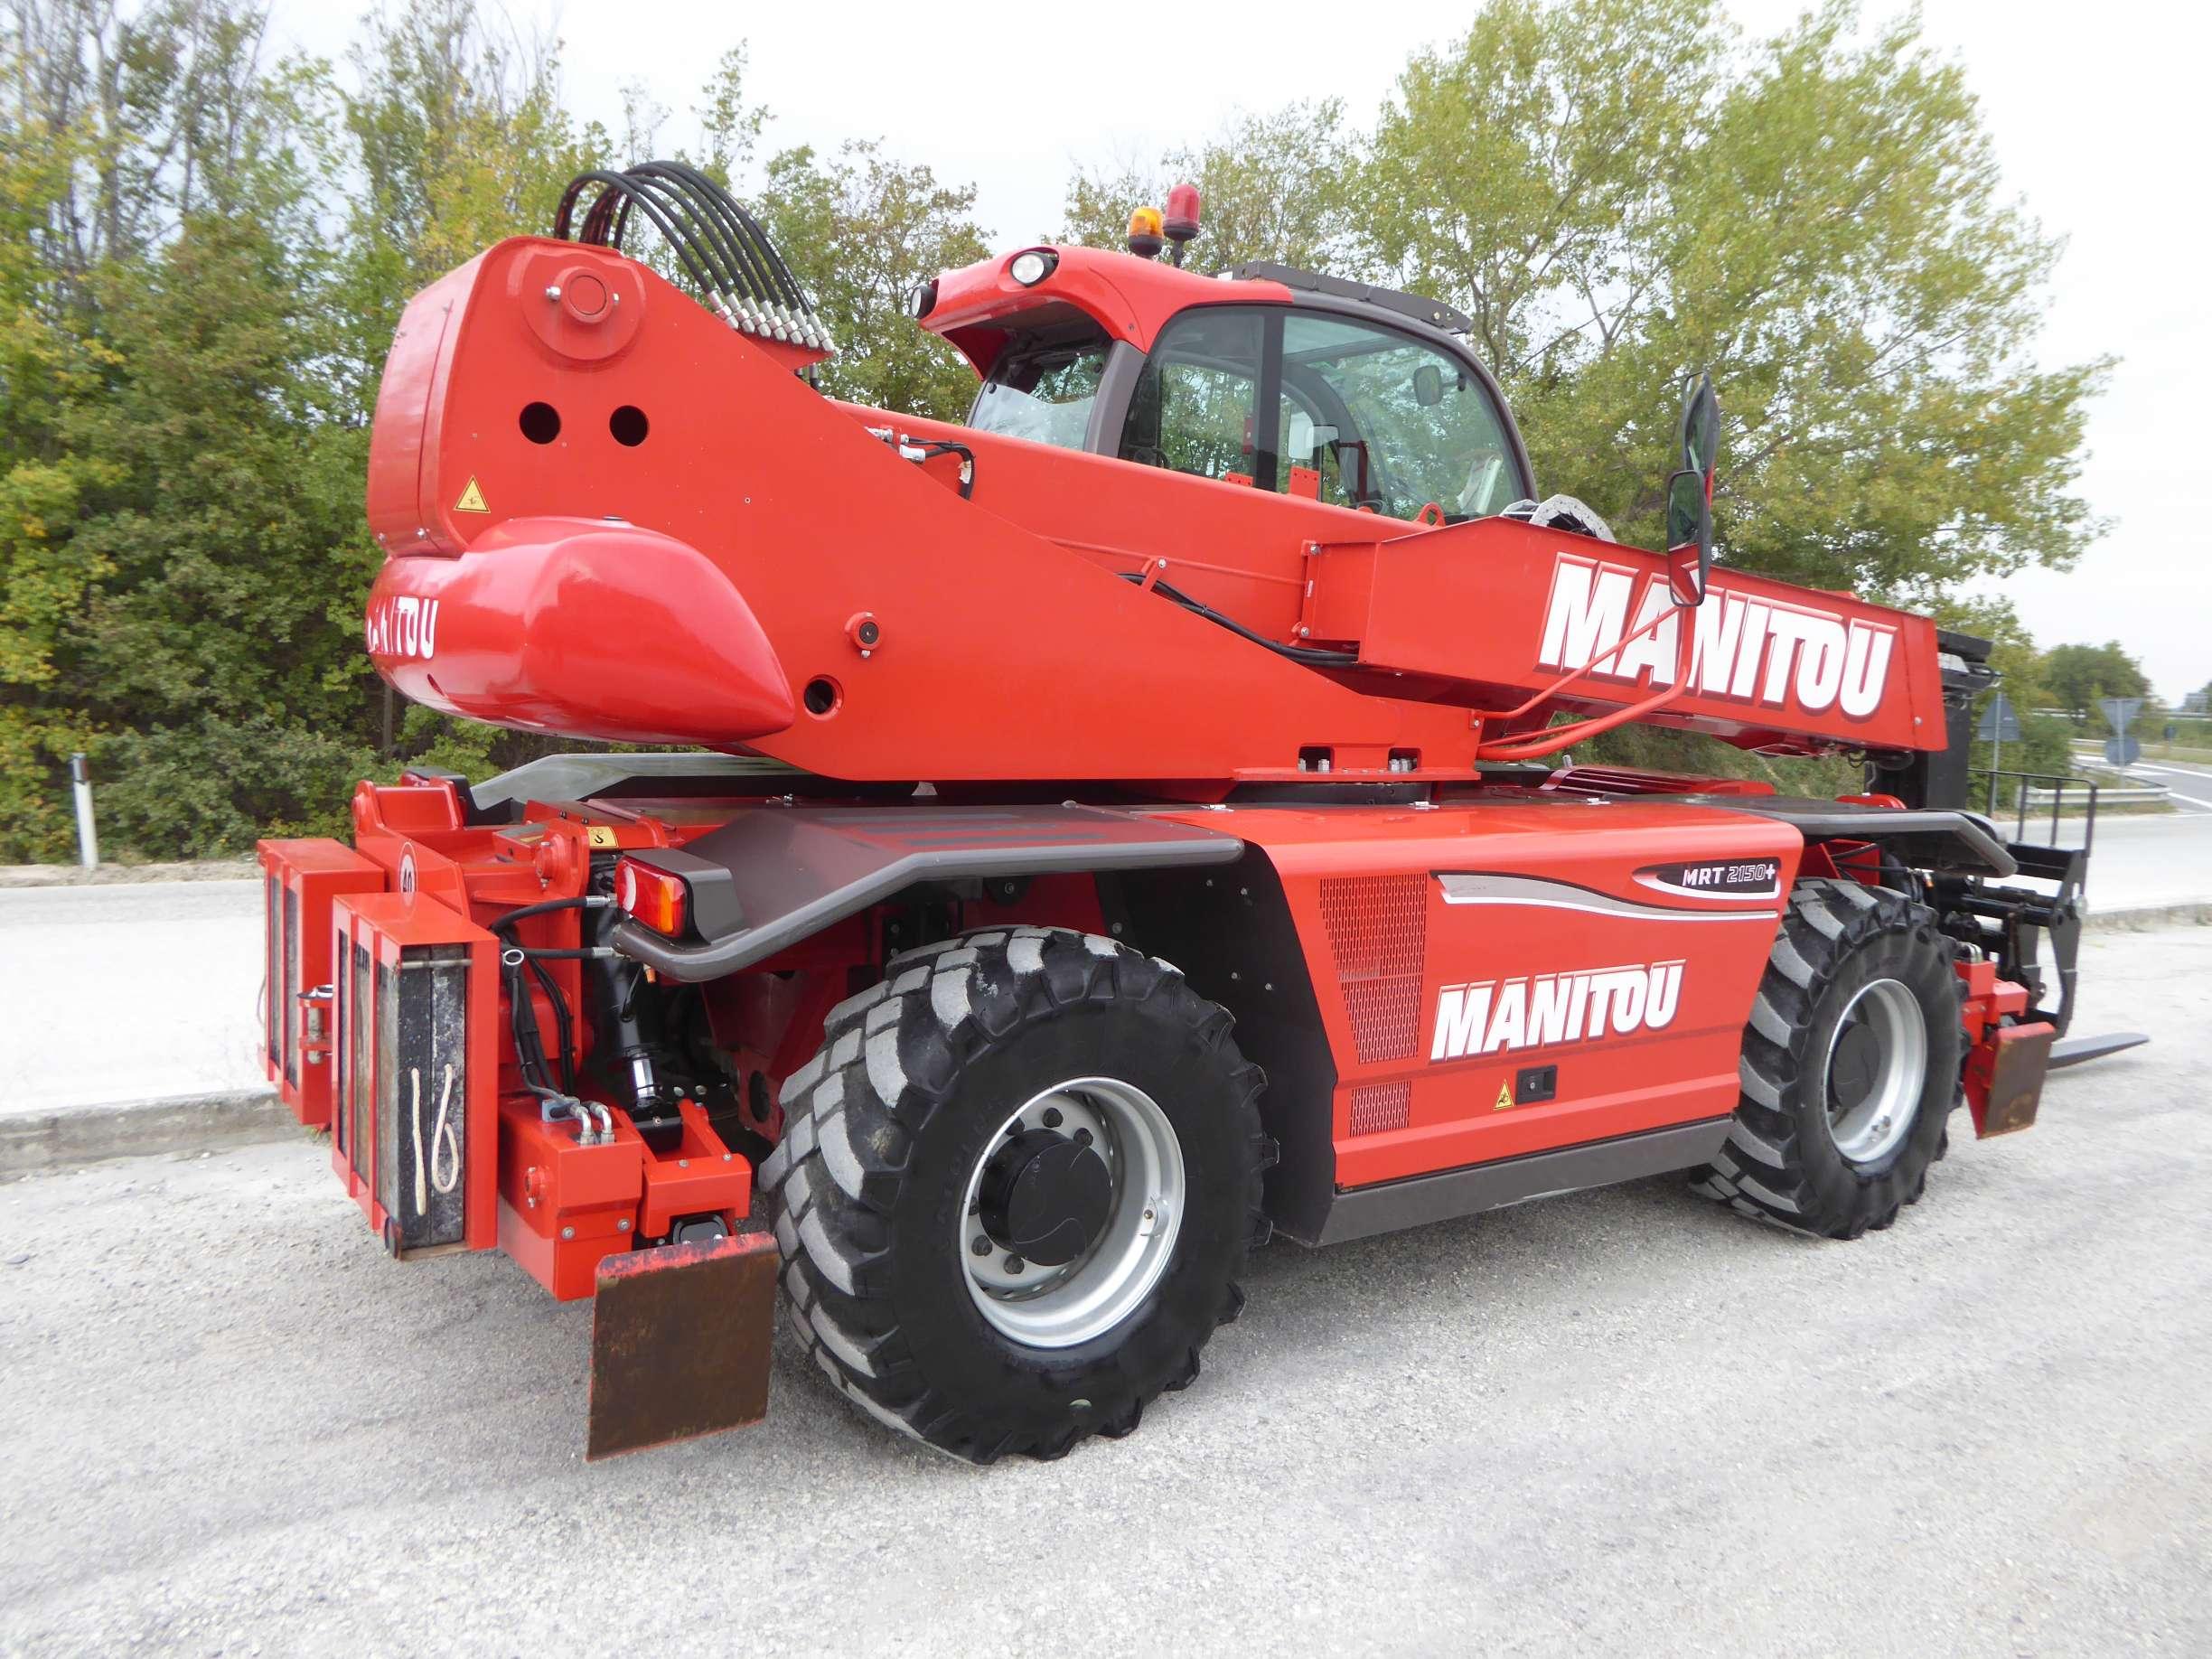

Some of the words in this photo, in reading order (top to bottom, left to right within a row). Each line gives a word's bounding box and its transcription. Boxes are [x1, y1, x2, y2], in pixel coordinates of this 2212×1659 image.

[1534, 552, 1897, 719] MANITOU
[1682, 867, 1725, 886] MRT
[1727, 863, 1776, 883] 2150+
[1430, 959, 1686, 1064] MANITOU
[411, 1063, 459, 1216] 16
